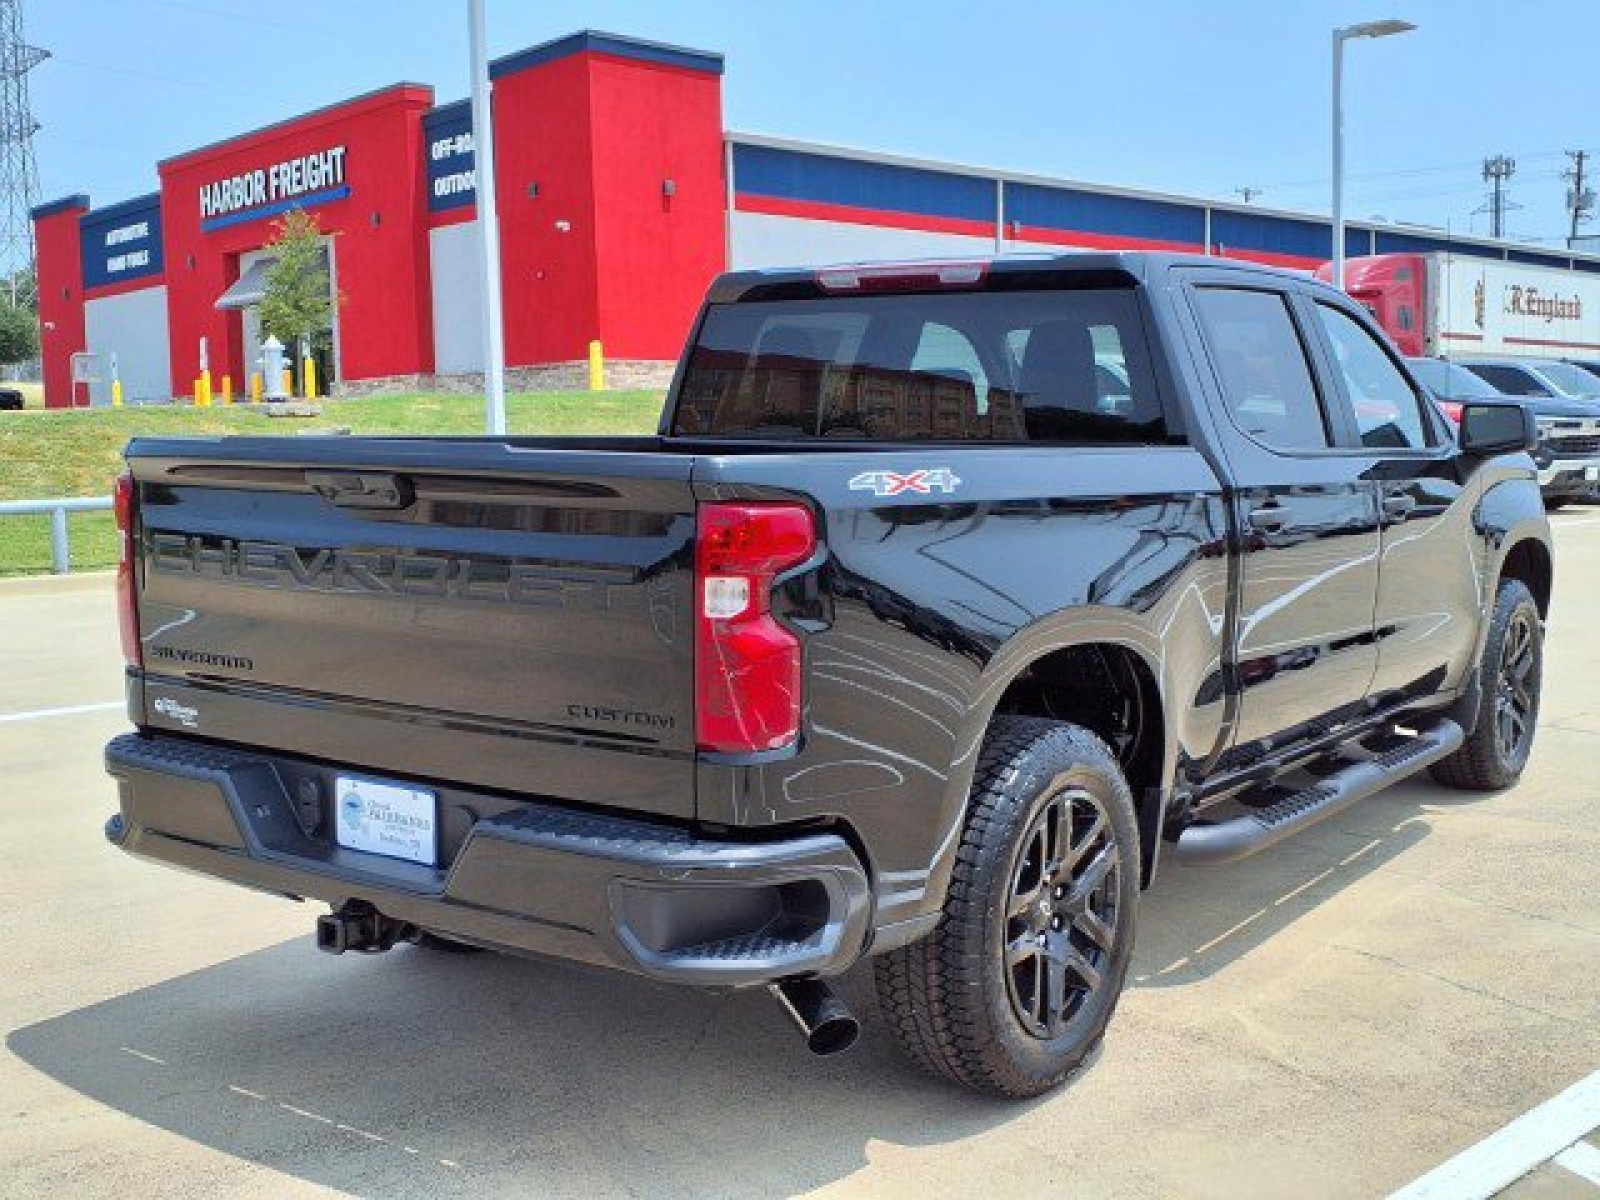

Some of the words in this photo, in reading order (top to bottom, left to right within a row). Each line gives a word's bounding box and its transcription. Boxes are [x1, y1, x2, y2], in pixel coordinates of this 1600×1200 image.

[200, 169, 266, 218] HARBOR
[269, 146, 346, 200] FREIGHT
[152, 533, 638, 608] CHEVROLET
[151, 645, 254, 671] SILVERADO
[567, 704, 676, 729] CUSTOM
